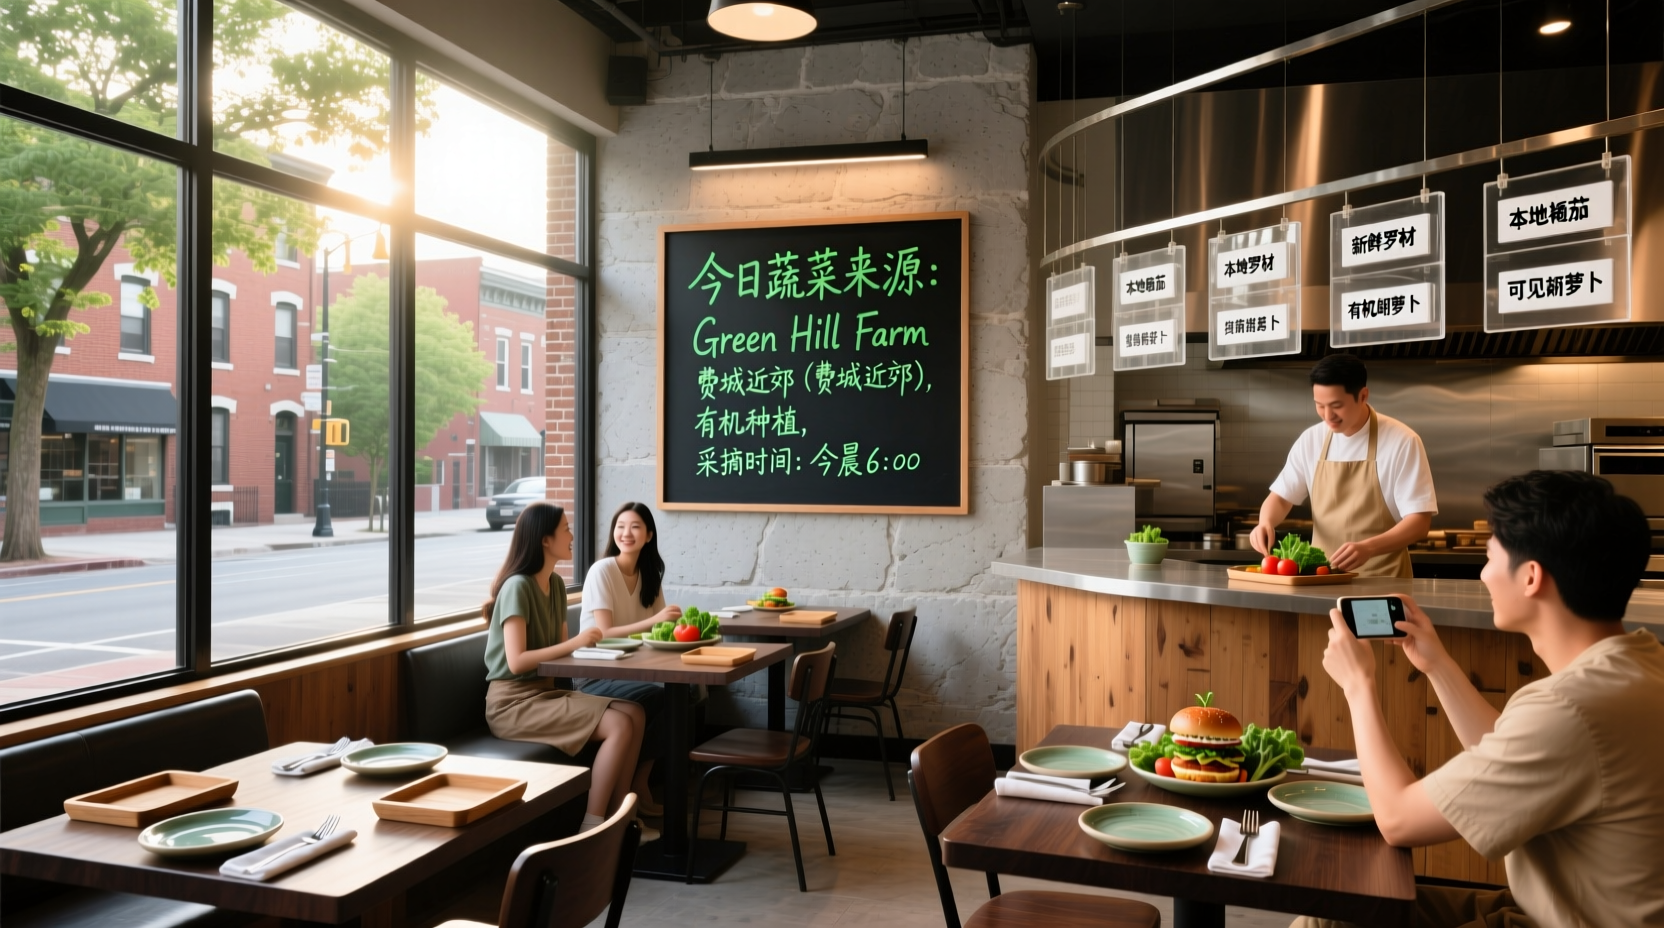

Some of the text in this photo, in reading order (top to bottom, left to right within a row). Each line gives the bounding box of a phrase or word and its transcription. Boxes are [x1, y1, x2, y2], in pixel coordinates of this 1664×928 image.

[688, 246, 938, 306] 今日蔬菜来源：
[692, 310, 930, 359] Green Hill Farm
[694, 405, 808, 439] 有机种植，
